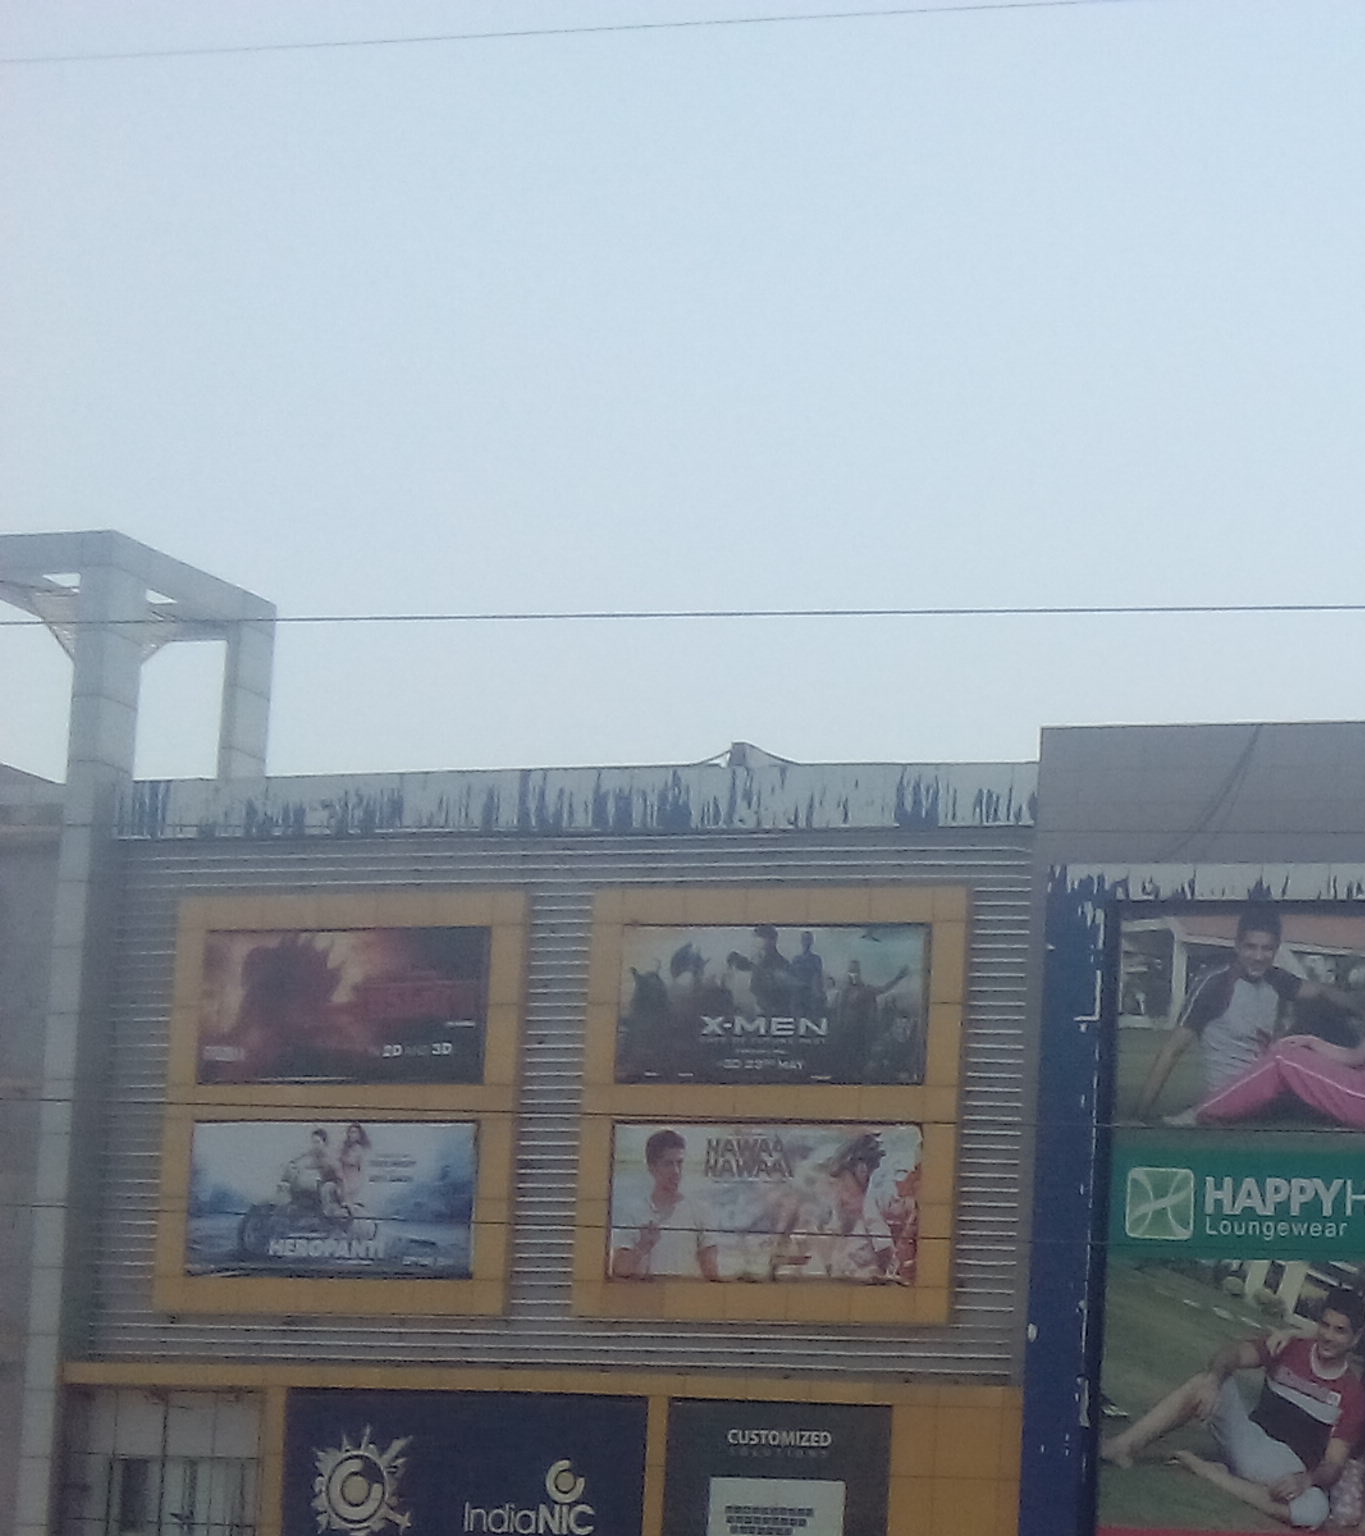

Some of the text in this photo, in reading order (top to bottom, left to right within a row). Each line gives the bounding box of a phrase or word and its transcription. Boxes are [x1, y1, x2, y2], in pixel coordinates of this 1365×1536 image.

[700, 1015, 829, 1036] X-MEN
[432, 1043, 453, 1055] 3D
[1205, 1215, 1348, 1242] Loungewear
[726, 1428, 833, 1448] CUSTOMIZED
[464, 1500, 595, 1536] IndiaNIC
